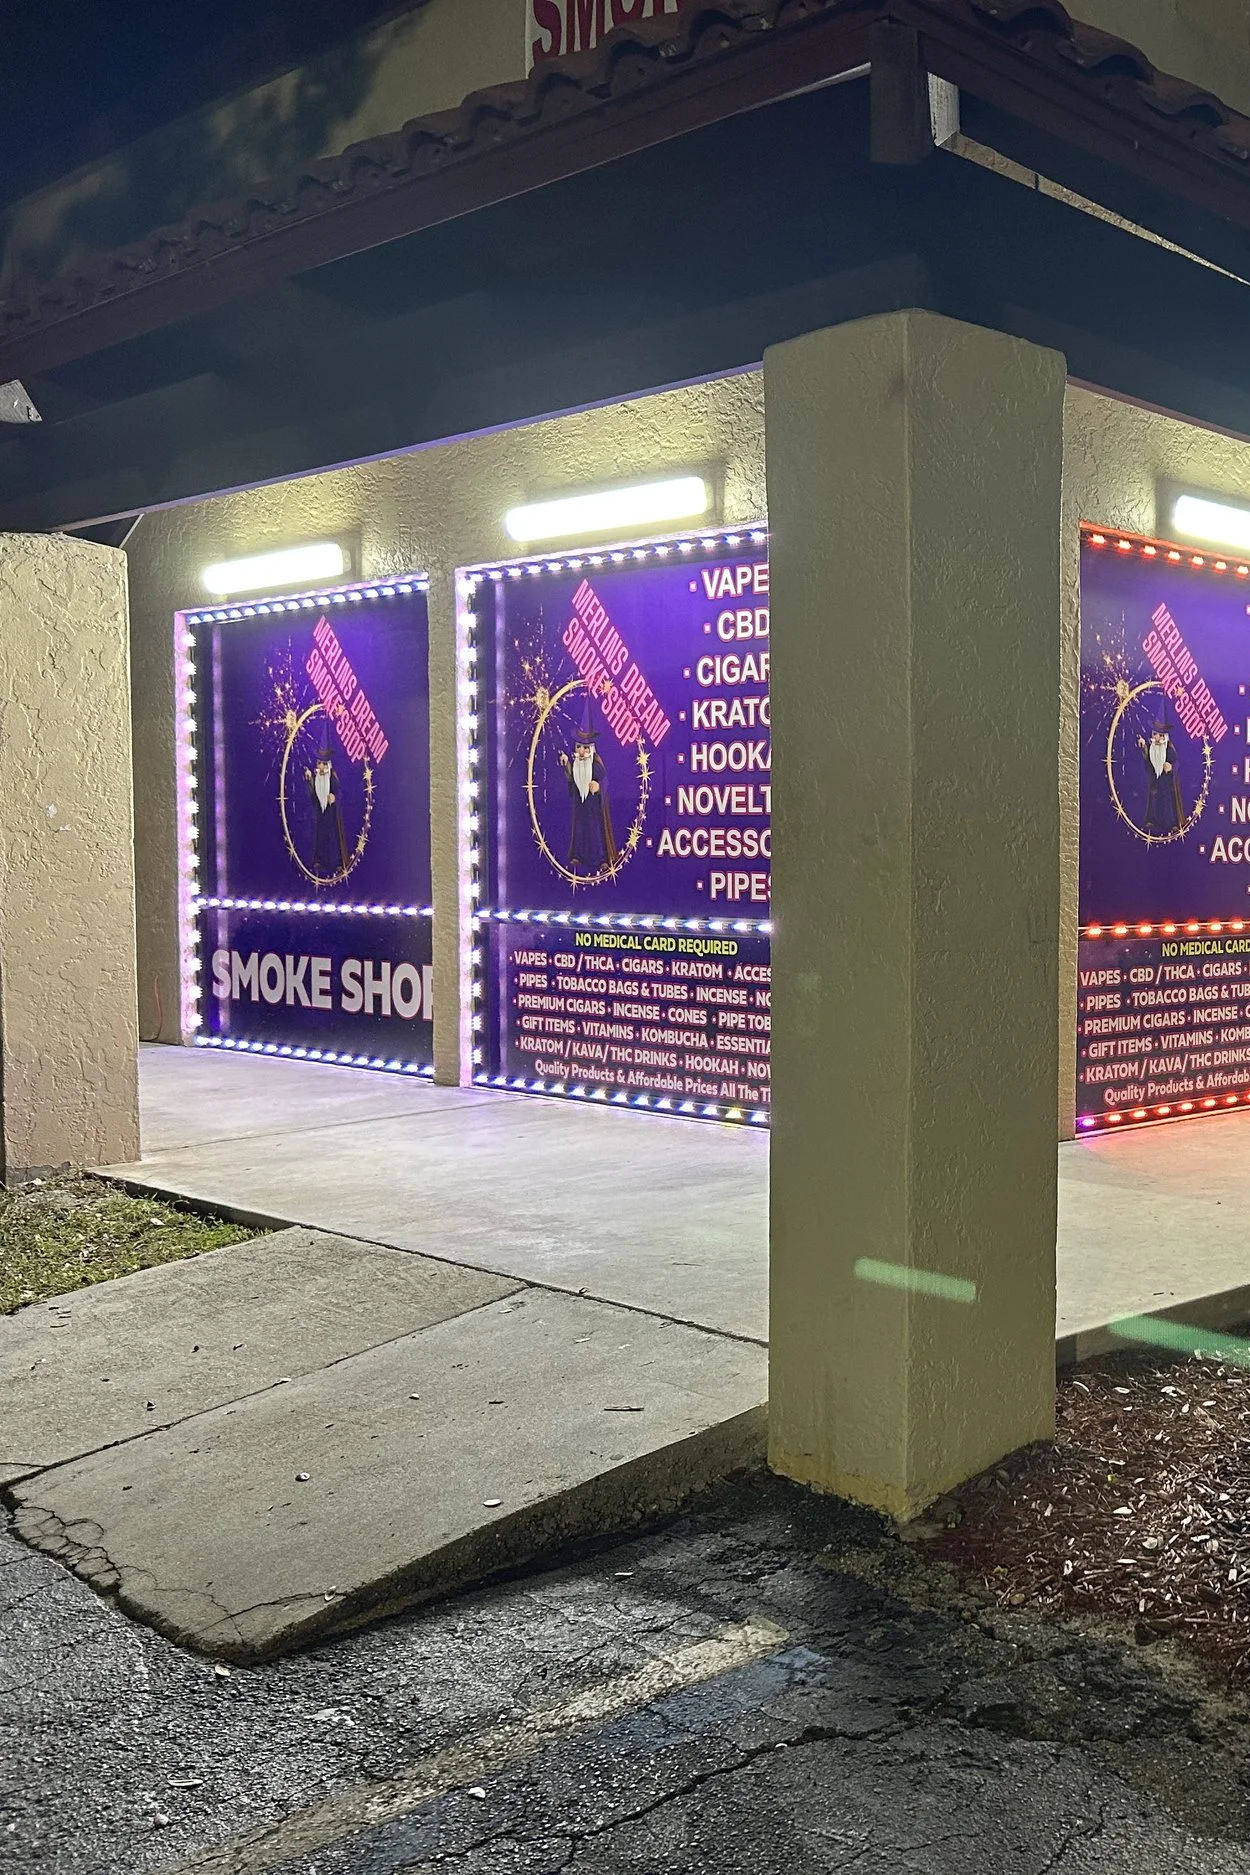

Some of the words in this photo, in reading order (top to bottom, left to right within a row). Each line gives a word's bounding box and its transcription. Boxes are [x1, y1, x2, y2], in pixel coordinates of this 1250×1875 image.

[531, 0, 678, 59] SM
[701, 563, 769, 599] VAPE
[717, 607, 770, 641] CBD
[572, 579, 628, 676] MERLINS
[620, 663, 671, 747] DREAM
[696, 652, 770, 686] CIGAR
[1152, 602, 1198, 685] MERLINS
[1191, 678, 1228, 743] DREAM
[313, 615, 357, 700] MERLINS
[351, 689, 389, 764] DREAM
[563, 617, 609, 699] SMOKE
[601, 686, 640, 746] SHOP
[1142, 631, 1182, 699] SMOKE
[1175, 693, 1206, 739] SHOP
[306, 649, 342, 720] SMOKE
[336, 711, 366, 763] SHOP
[692, 697, 770, 730] KRATO
[690, 740, 771, 772] HOOK
[677, 785, 771, 815] NOVELT
[657, 827, 771, 858] ACCESSO
[576, 933, 591, 946] NO
[594, 934, 641, 950] MEDICAL
[644, 937, 676, 951] CARD
[678, 939, 738, 956] REQUIRED
[1162, 944, 1178, 957] NO
[1180, 940, 1224, 956] MEDICAL
[212, 950, 332, 1009] SMOKE
[514, 951, 547, 966] VAPES
[554, 954, 575, 968] CBD
[584, 956, 614, 971] THCA
[622, 958, 664, 974] CIGARS
[672, 961, 723, 978] KRATOM
[1080, 970, 1121, 986] VAPES
[1130, 968, 1154, 983] CBD
[1164, 965, 1195, 980] THCA
[1203, 962, 1242, 977] CIGARS
[520, 973, 547, 988] PIPES
[556, 976, 606, 992] TOBACCO
[609, 980, 638, 996] BAGS
[641, 983, 650, 997] &
[652, 983, 688, 999] TUBES
[696, 987, 747, 1005] INCENSE
[1087, 994, 1121, 1011] PIPES
[1132, 989, 1186, 1007] TOBACCO
[1189, 986, 1219, 1001] BAGS
[1221, 986, 1229, 998] &
[519, 994, 564, 1011] PREMIUM
[566, 999, 605, 1014] CIGARS
[613, 1002, 660, 1020] INCENSE
[668, 1008, 707, 1025] CONES
[719, 1012, 745, 1028] PIPE
[1084, 1016, 1141, 1035] PREMIUM
[1143, 1011, 1185, 1028] CIGARS
[1194, 1005, 1238, 1023] INCENSE
[522, 1016, 543, 1030] GIFT
[545, 1018, 575, 1033] ITEMS
[582, 1022, 634, 1039] VITAMINS
[642, 1028, 708, 1048] KOMBUCHA
[716, 1035, 771, 1054] ESSENTI
[1089, 1042, 1116, 1058] GIFT
[1118, 1037, 1152, 1054] ITEMS
[1161, 1031, 1213, 1049] VITAMINS
[520, 1036, 563, 1054] KRATOM
[611, 1047, 632, 1062] THC
[635, 1051, 677, 1067] DRINKS
[685, 1055, 739, 1075] HOOKAH
[1087, 1062, 1138, 1082] KRATOM
[1190, 1052, 1212, 1068] THC
[535, 1059, 569, 1079] Quality
[572, 1063, 614, 1081] Products
[616, 1072, 625, 1083] &
[630, 1070, 683, 1091] Affordable
[685, 1079, 718, 1095] Prices
[720, 1082, 735, 1098] All
[737, 1084, 759, 1100] The
[1105, 1085, 1145, 1106] Quality
[1148, 1077, 1194, 1097] Products
[1195, 1076, 1204, 1089] &
